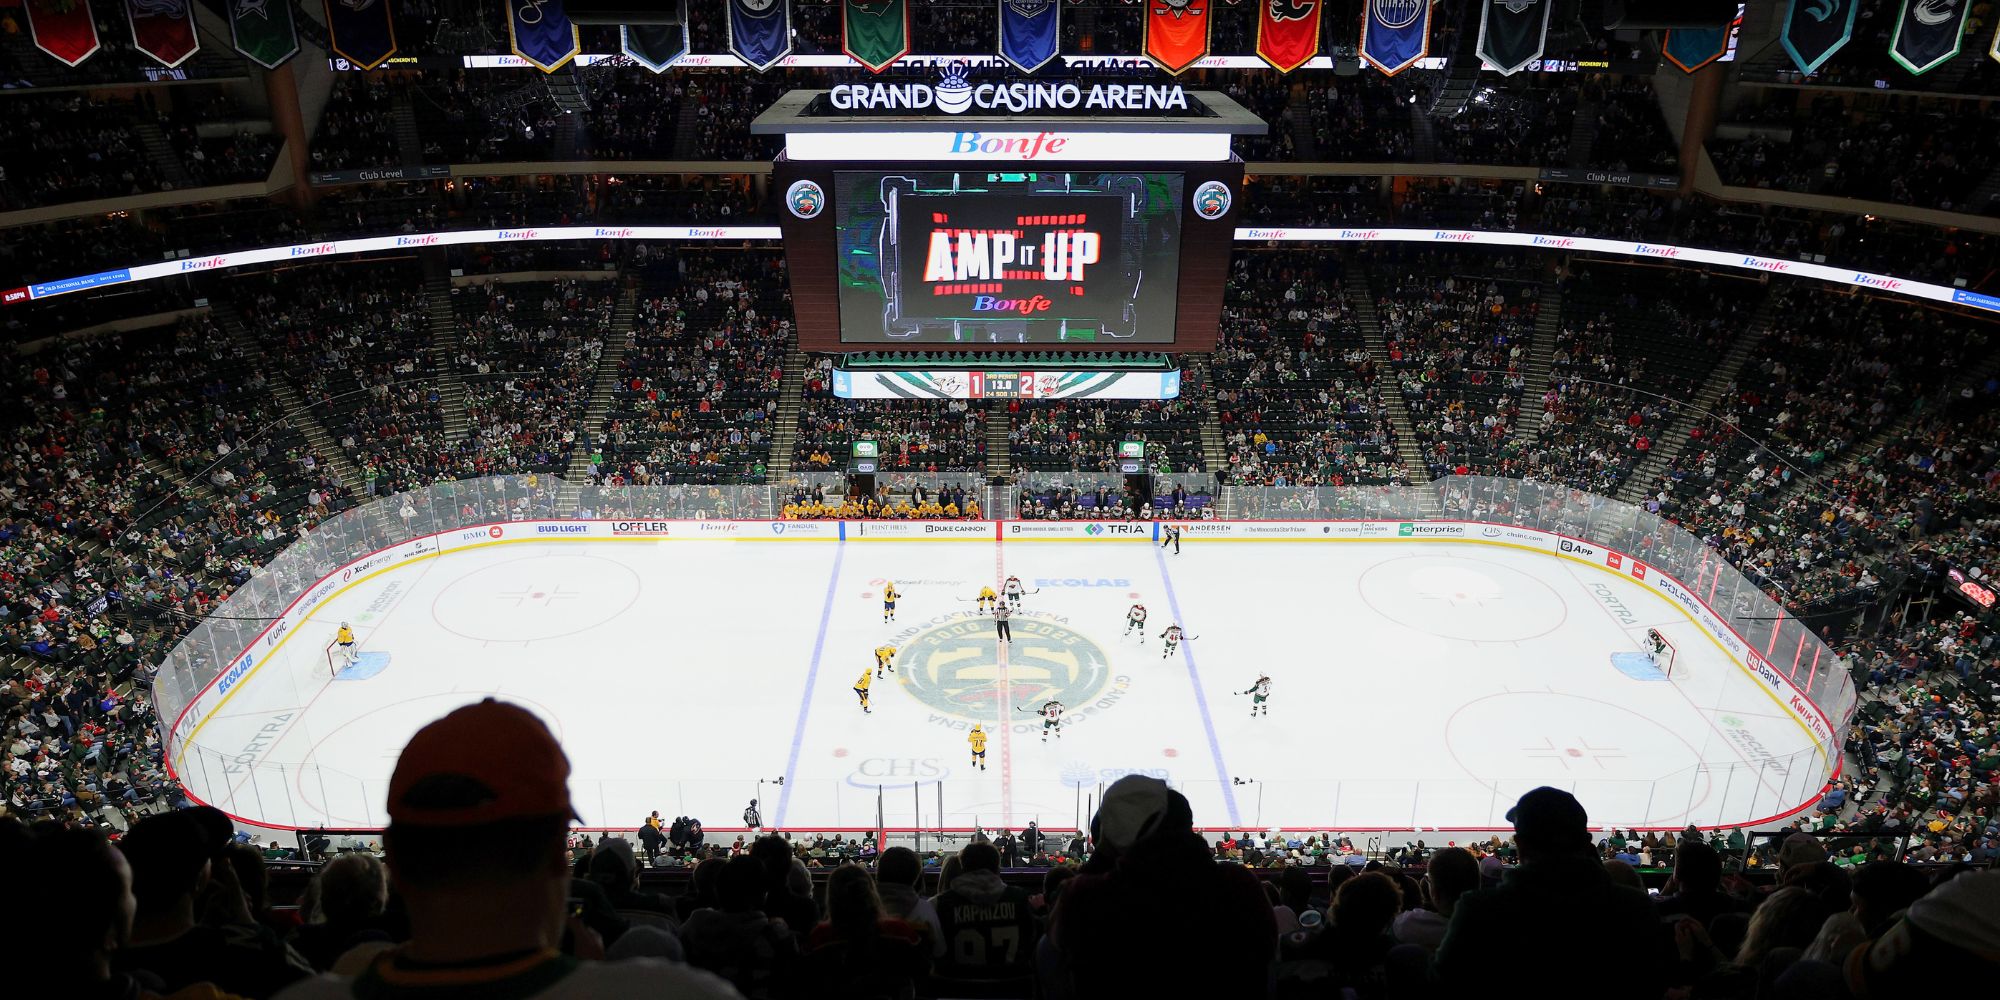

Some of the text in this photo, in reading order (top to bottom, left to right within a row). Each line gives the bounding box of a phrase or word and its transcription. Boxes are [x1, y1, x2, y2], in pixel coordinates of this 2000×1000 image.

[1195, 57, 1228, 67] onfe
[831, 83, 1188, 113] GRAND CASINO ARENA
[949, 131, 1065, 159] Bonfe
[359, 170, 403, 180] Club Level
[1586, 173, 1630, 183] Club Level
[498, 229, 538, 240] Bonfe
[595, 228, 633, 238] Bonfe
[689, 228, 726, 238] Bonfe
[1248, 229, 1286, 239] Bonfe
[1340, 230, 1379, 240] Bonfe
[1434, 231, 1475, 242] Bonfe
[397, 235, 439, 246] Bonfe
[1533, 236, 1574, 248] Bonfe
[291, 243, 334, 256] Bonfe
[1635, 244, 1679, 258] Bonfe
[923, 231, 1100, 282] AMP IT UP
[181, 256, 226, 271] Bonfe
[1743, 256, 1790, 272] Bonfe
[57, 281, 81, 290] NATIONAL
[80, 278, 95, 286] BANK
[1854, 273, 1901, 291] Bonfe
[972, 296, 1052, 314] Bonfe
[973, 376, 980, 394] 1
[1022, 376, 1032, 394] 2
[559, 525, 587, 533] LIGHT
[612, 522, 668, 531] LOFFLER
[1108, 525, 1144, 533] TRIA
[1404, 525, 1463, 534] enterprise
[463, 531, 486, 541] BMO
[1507, 531, 1543, 542] chsinc.com
[317, 581, 335, 598] CASINO
[1035, 578, 1130, 588] ECOLAB
[1660, 579, 1700, 615] POLARIS
[1590, 583, 1638, 625] FORTRA
[273, 621, 287, 640] UHC
[218, 654, 253, 695] ECOLAB
[1759, 661, 1780, 690] bank
[224, 713, 294, 774] FORTRA
[860, 758, 940, 777] CHS
[954, 902, 1015, 924] KAPRIZOV
[955, 925, 1019, 964] 97
